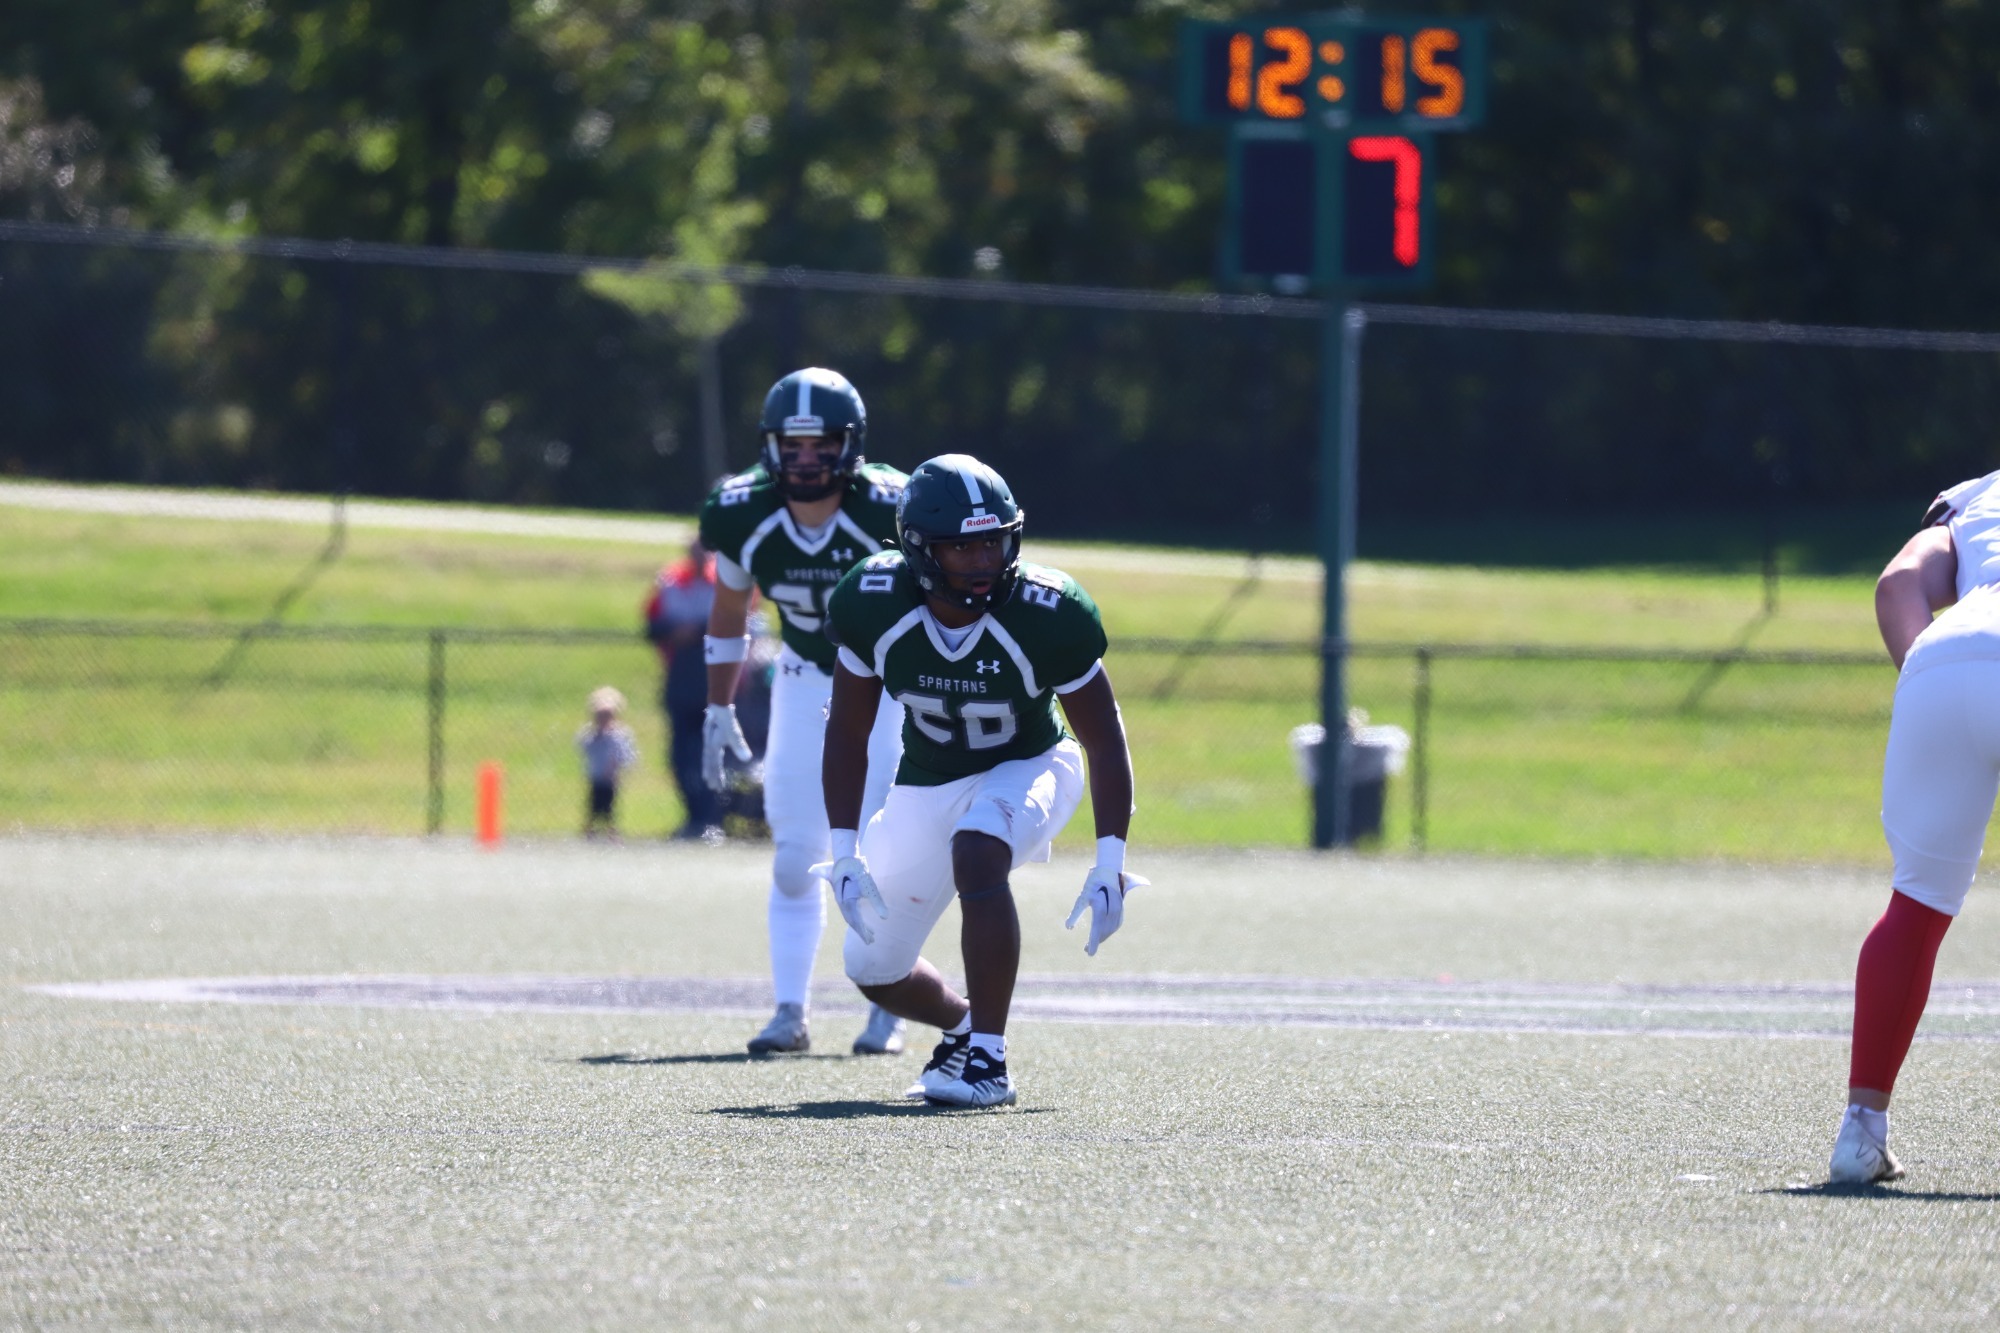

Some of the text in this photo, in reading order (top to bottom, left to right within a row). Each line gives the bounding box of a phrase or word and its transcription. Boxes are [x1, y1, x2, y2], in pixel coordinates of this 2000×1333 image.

[1227, 26, 1465, 119] 12:15
[1348, 135, 1422, 268] 7
[966, 516, 996, 527] Riddell
[918, 675, 987, 694] SPARTANS
